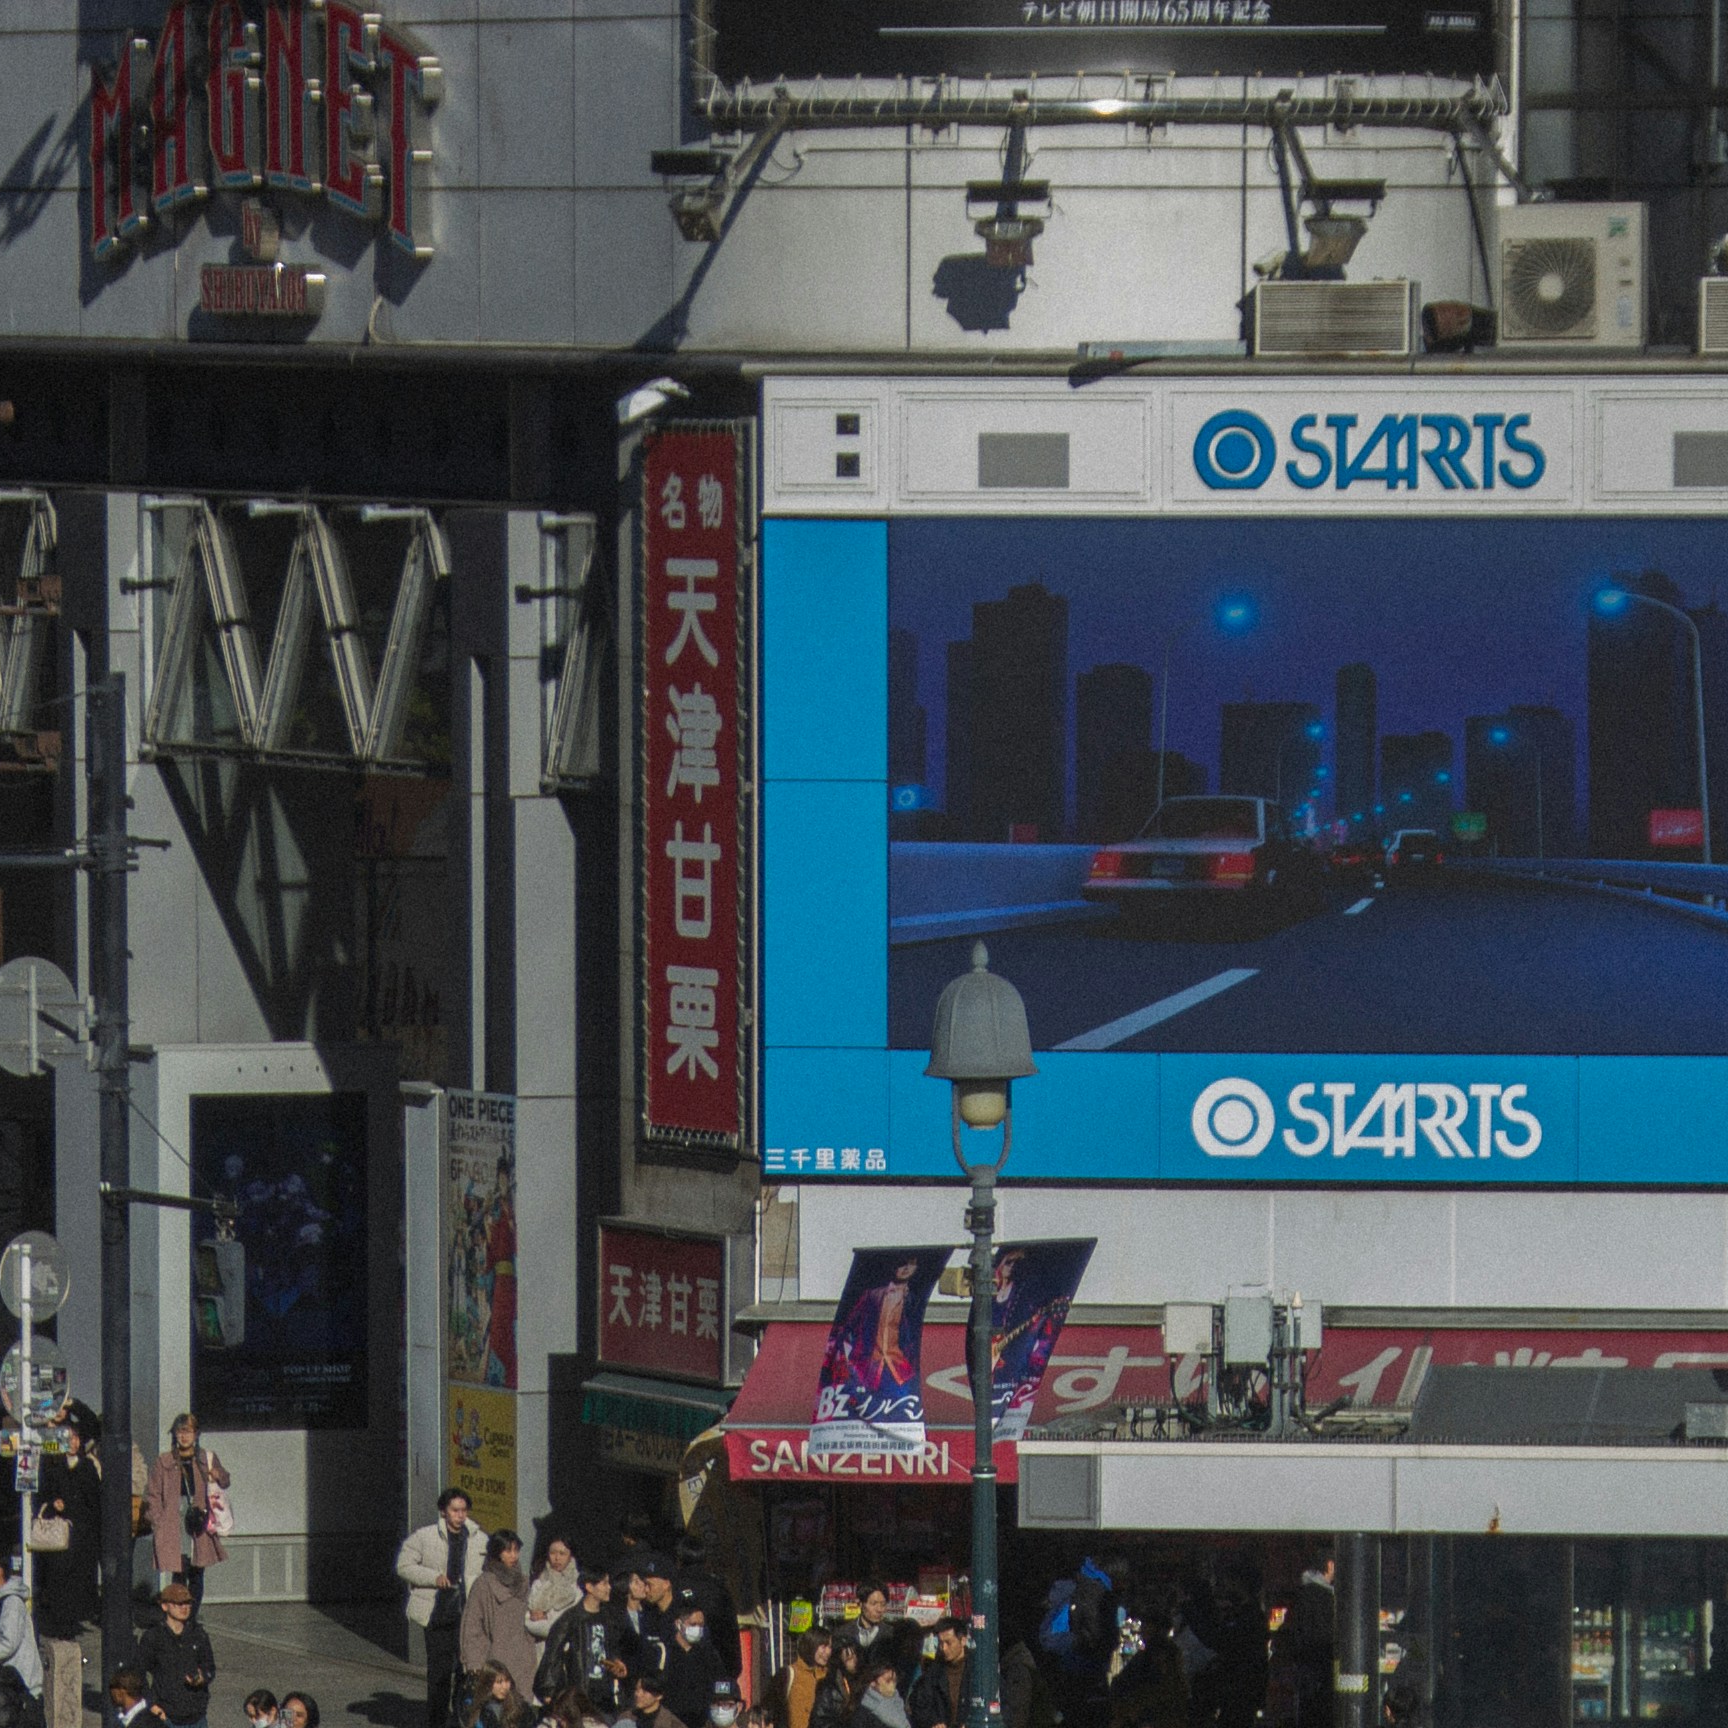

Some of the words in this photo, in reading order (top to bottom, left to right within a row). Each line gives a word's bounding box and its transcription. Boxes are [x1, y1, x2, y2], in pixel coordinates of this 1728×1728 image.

[89, 0, 424, 261] MAGNET
[200, 267, 308, 313] SHIBUYA109
[1286, 412, 1547, 491] STARTS
[660, 472, 724, 532] 名物
[665, 557, 722, 1083] 天津甘栗
[449, 1095, 475, 1119] ONE
[478, 1100, 515, 1124] PIECE
[1281, 1081, 1543, 1160] STARTS
[764, 1147, 888, 1172] 三千里薬品
[607, 1262, 722, 1342] 天津甘栗
[816, 1384, 850, 1420] B'z
[750, 1438, 950, 1476] SANZENRI
